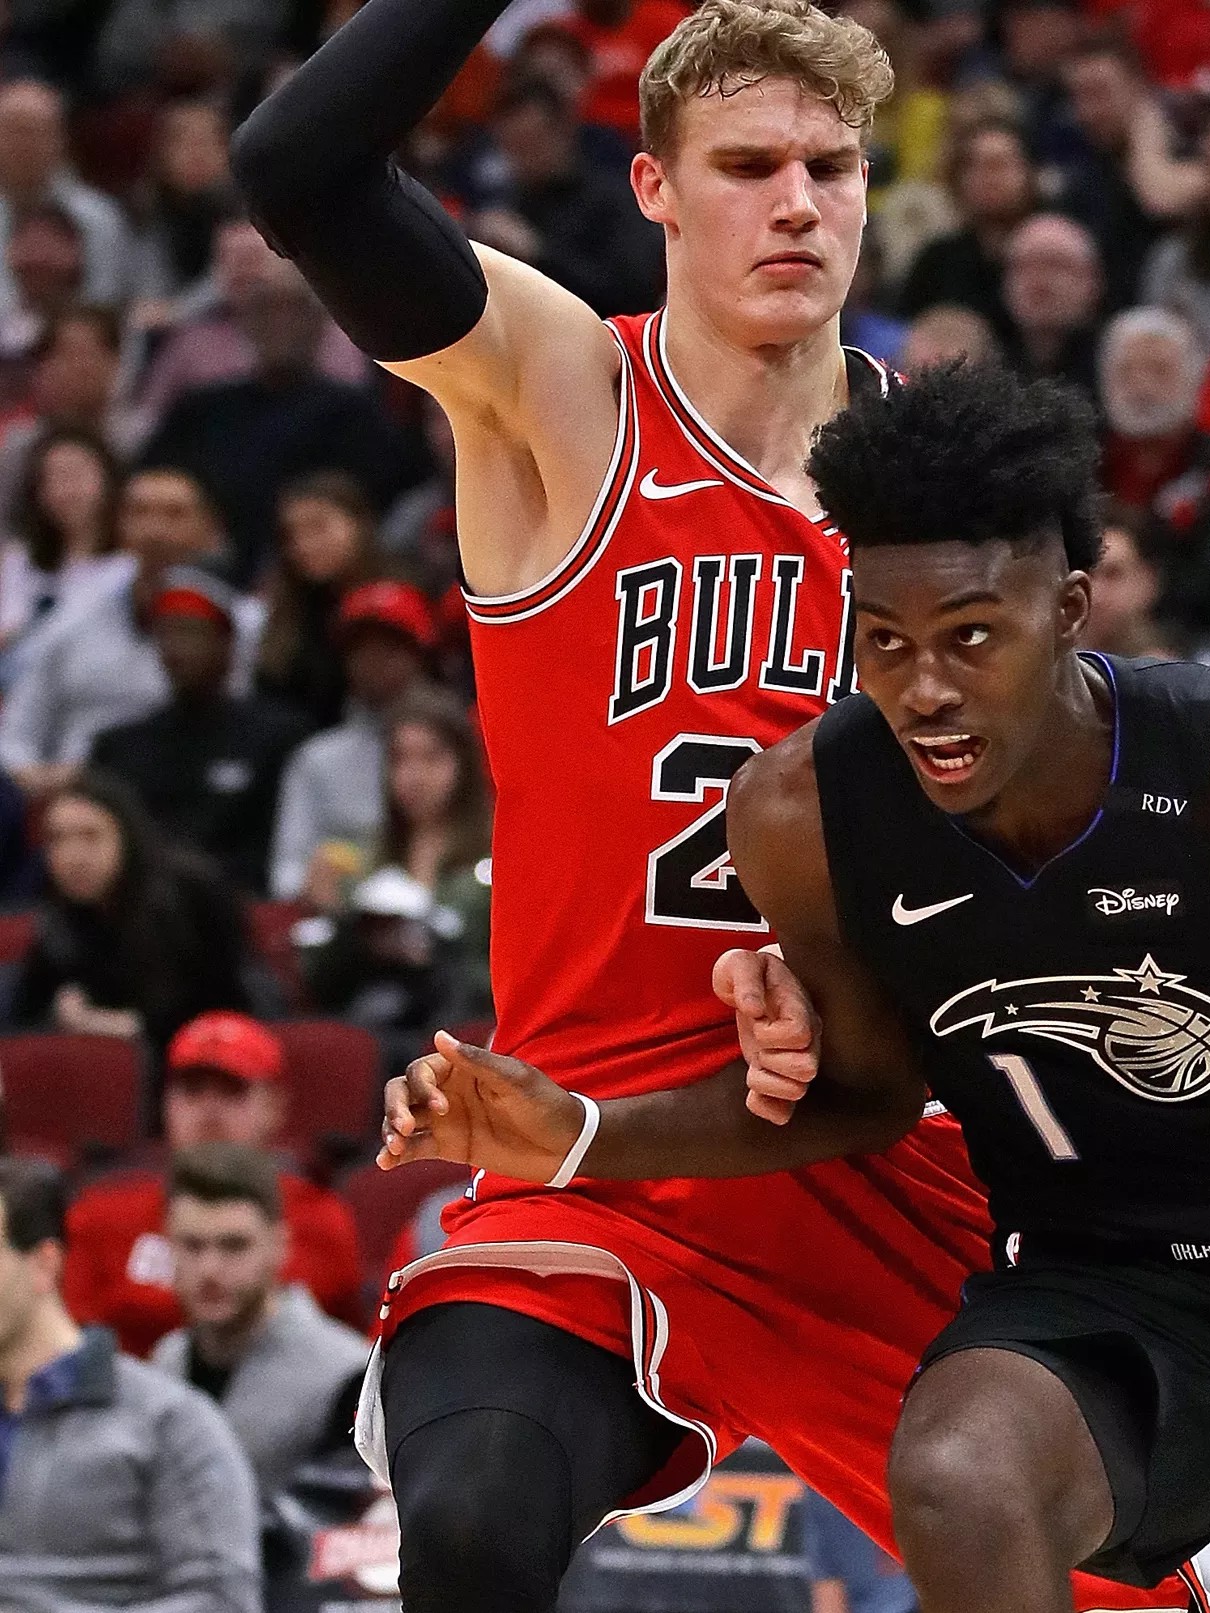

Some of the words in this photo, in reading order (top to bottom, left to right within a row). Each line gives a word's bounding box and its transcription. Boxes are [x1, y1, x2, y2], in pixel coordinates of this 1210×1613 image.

[1141, 793, 1188, 816] RDV
[1087, 888, 1180, 916] Disney
[985, 1053, 1079, 1160] 1
